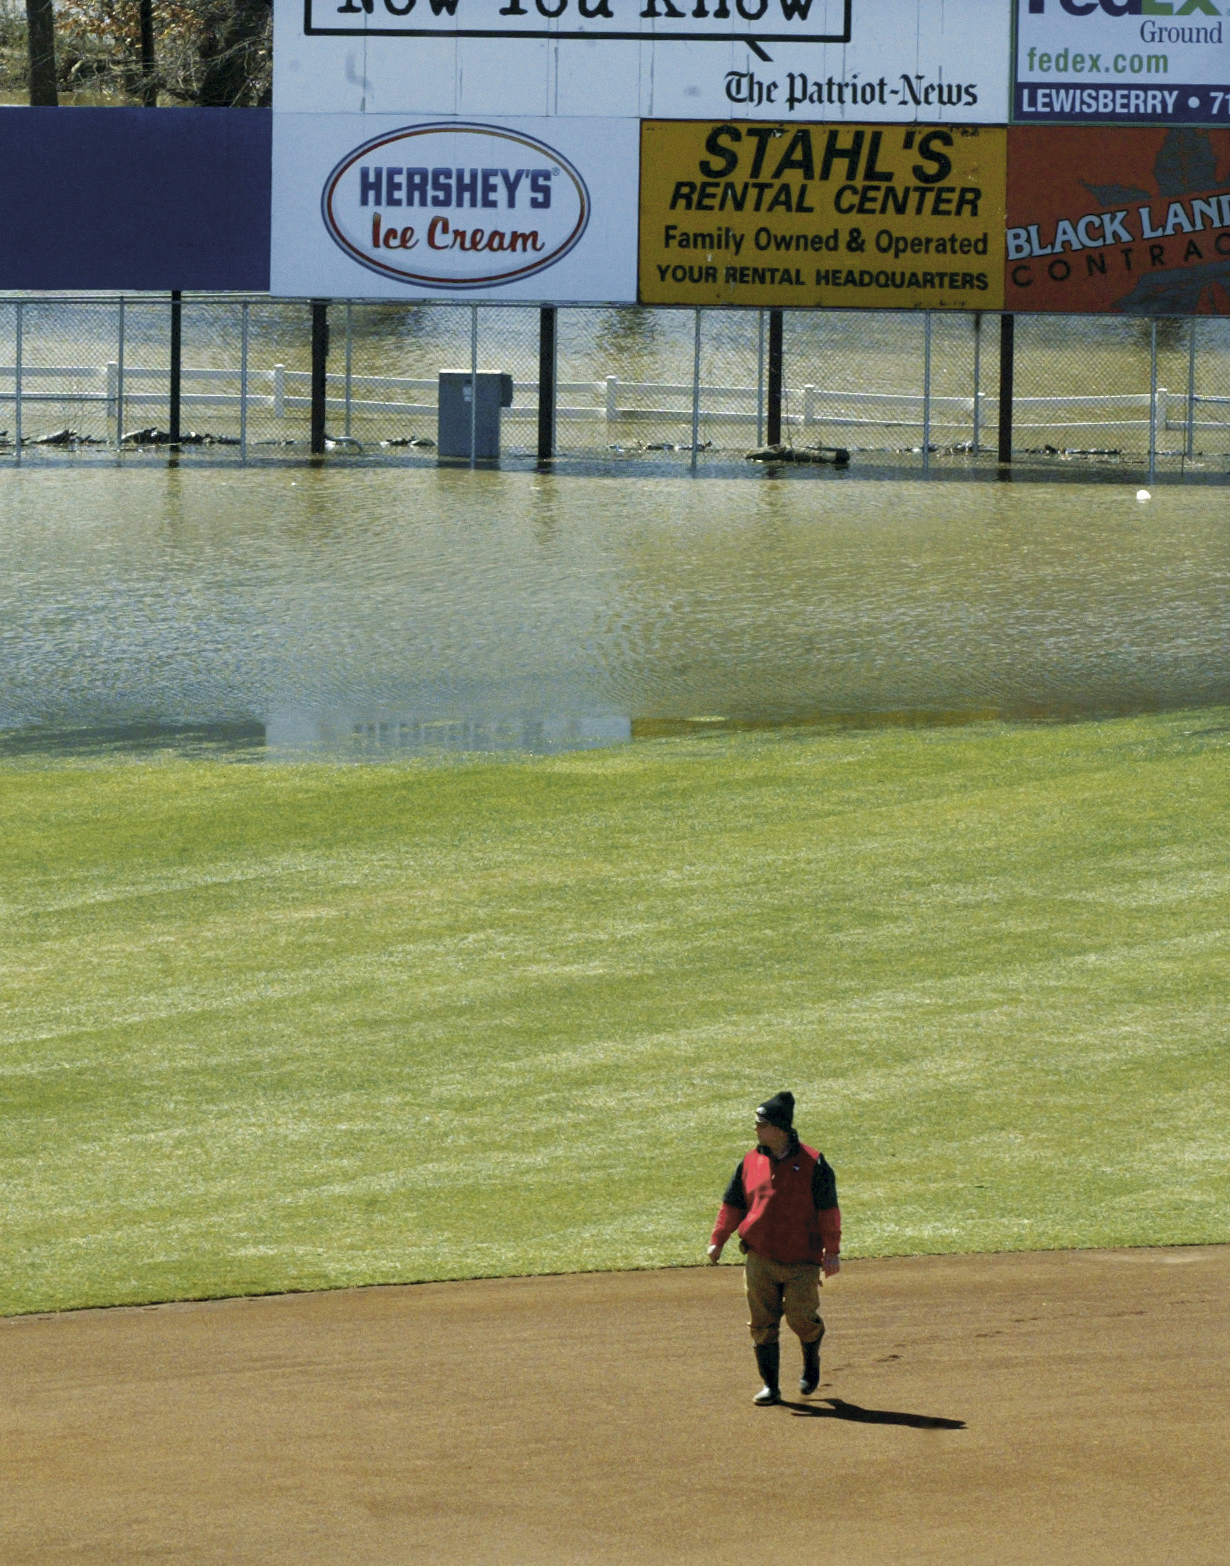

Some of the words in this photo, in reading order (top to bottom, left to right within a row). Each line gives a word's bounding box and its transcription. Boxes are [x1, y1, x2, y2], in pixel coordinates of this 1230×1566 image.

[1140, 20, 1223, 44] Ground
[1027, 47, 1169, 74] fedex.com
[724, 70, 779, 107] The
[786, 72, 978, 112] Patriot-News
[1022, 88, 1179, 114] LEWISBERRY
[698, 125, 954, 184] STAHL'S
[360, 166, 552, 209] HERSHEY'S
[669, 181, 815, 213] RENTAL
[833, 184, 983, 217] CENTER
[372, 211, 419, 249] Ice
[427, 215, 545, 252] Cream
[664, 225, 744, 255] Family
[754, 227, 839, 252] Owned
[846, 227, 866, 253] &
[875, 229, 988, 259] Operated
[1005, 209, 1135, 261] BLACK
[656, 264, 718, 284] YOUR
[724, 265, 806, 286] RENTAL
[815, 269, 989, 291] HEADQUARTERS
